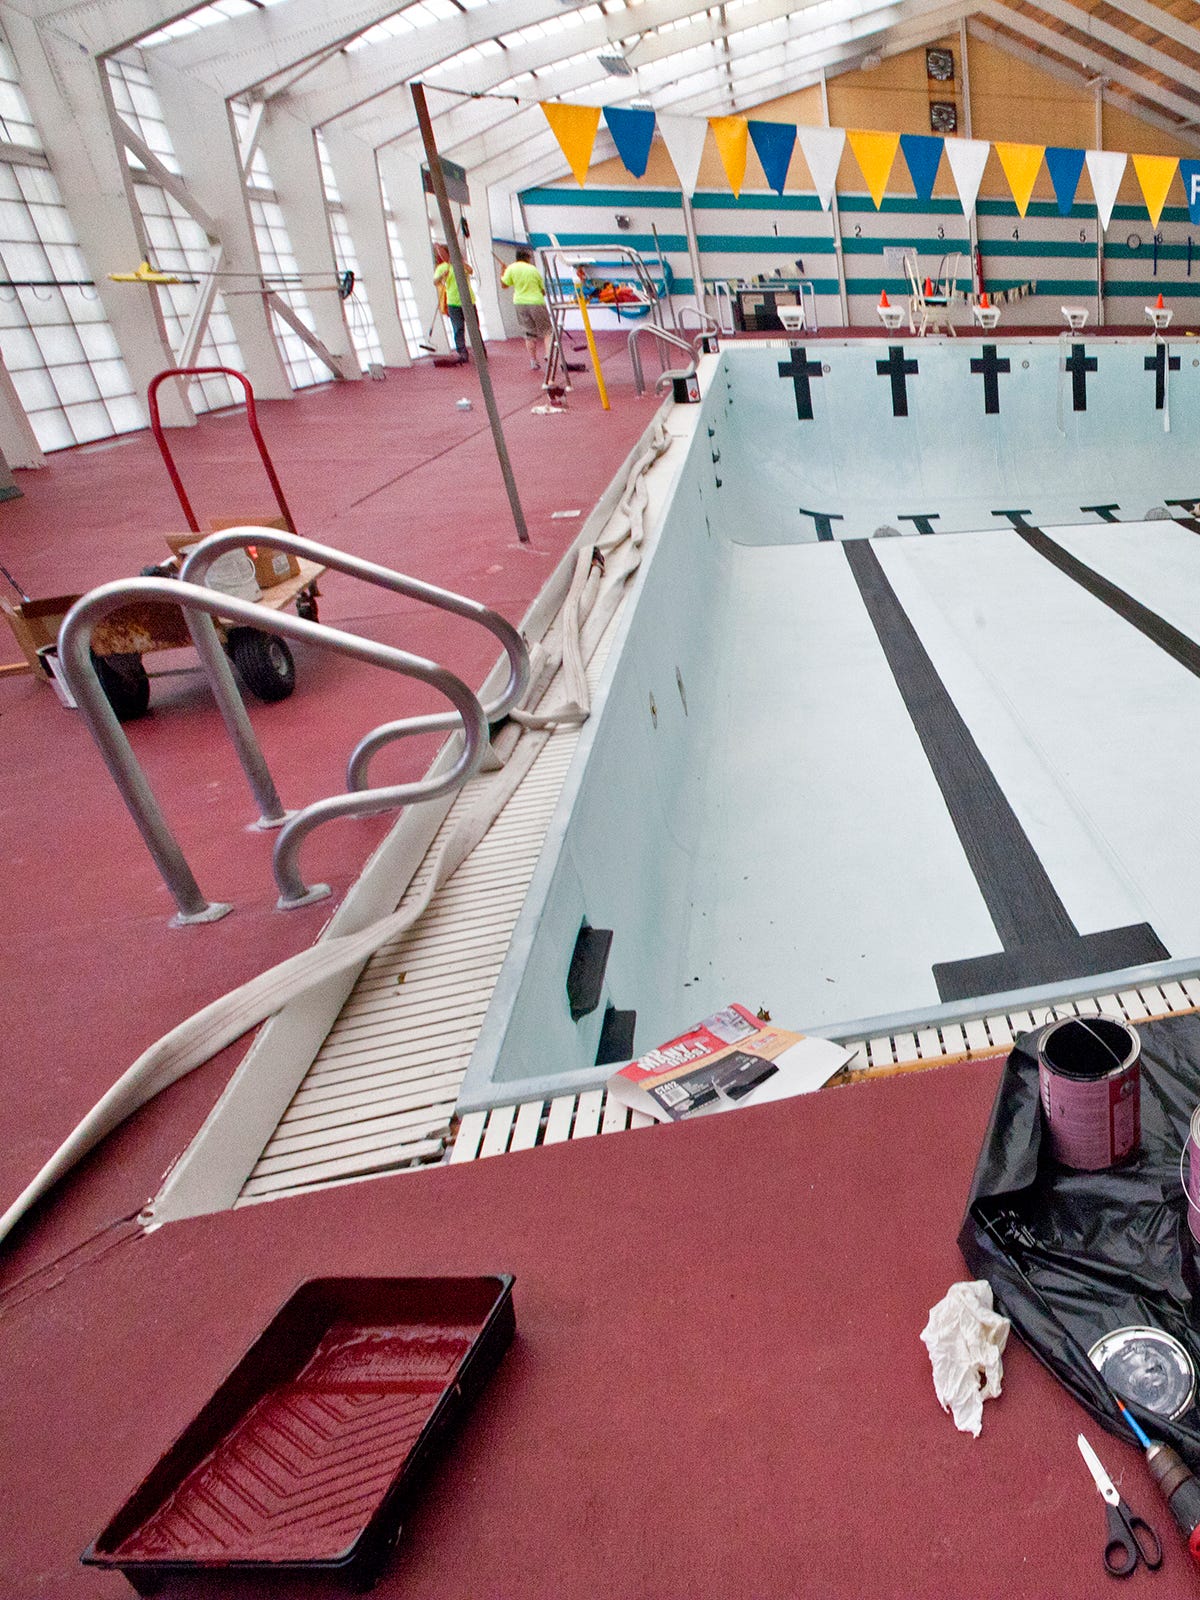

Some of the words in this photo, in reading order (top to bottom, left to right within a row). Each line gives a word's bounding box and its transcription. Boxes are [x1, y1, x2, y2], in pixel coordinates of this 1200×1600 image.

[855, 225, 862, 238] 2
[937, 227, 945, 239] 3
[1012, 228, 1019, 241] 4
[1079, 230, 1086, 243] 5
